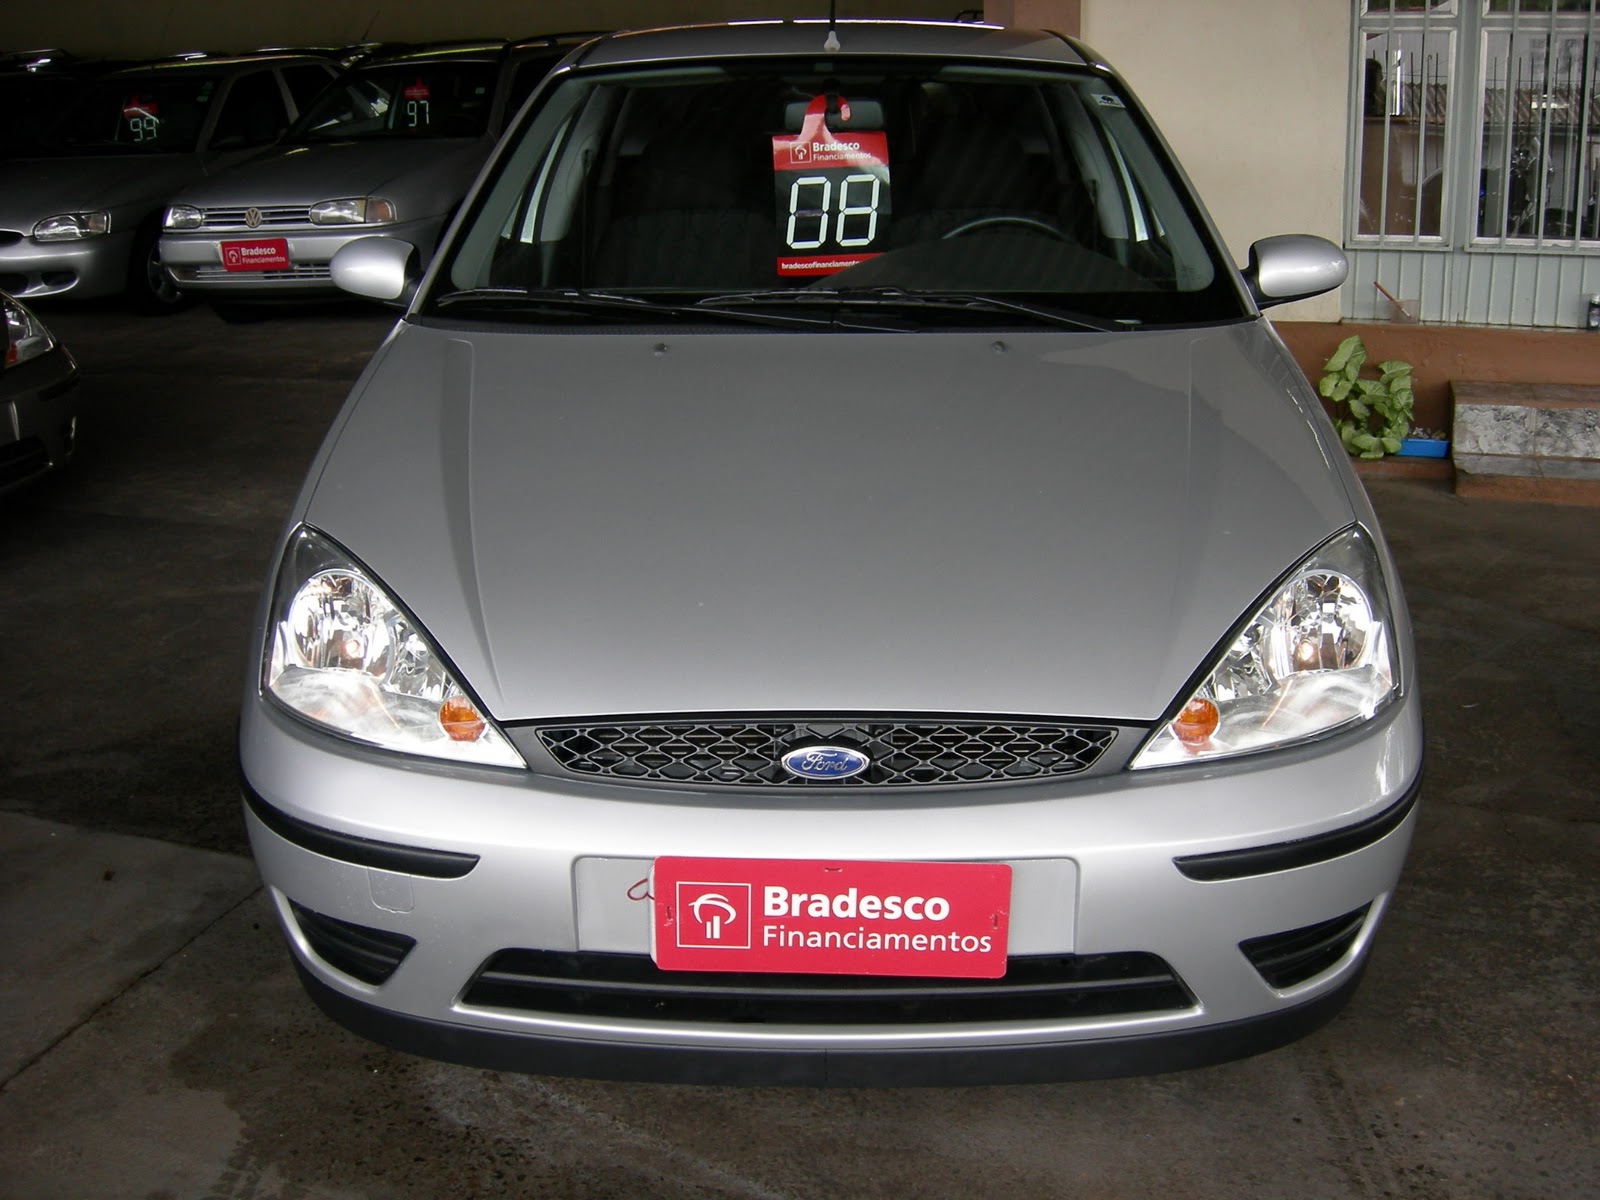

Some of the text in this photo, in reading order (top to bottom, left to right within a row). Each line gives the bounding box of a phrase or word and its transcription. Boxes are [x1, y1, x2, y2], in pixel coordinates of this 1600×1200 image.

[407, 100, 430, 127] 97
[812, 141, 861, 152] Bradesco
[812, 151, 872, 162] Financiamentos
[786, 174, 880, 249] 08
[241, 246, 277, 257] Bradesco
[242, 256, 286, 264] Financiamentos
[801, 751, 849, 771] Ford
[763, 885, 950, 921] Bradesco
[763, 924, 992, 953] Financiamentos
